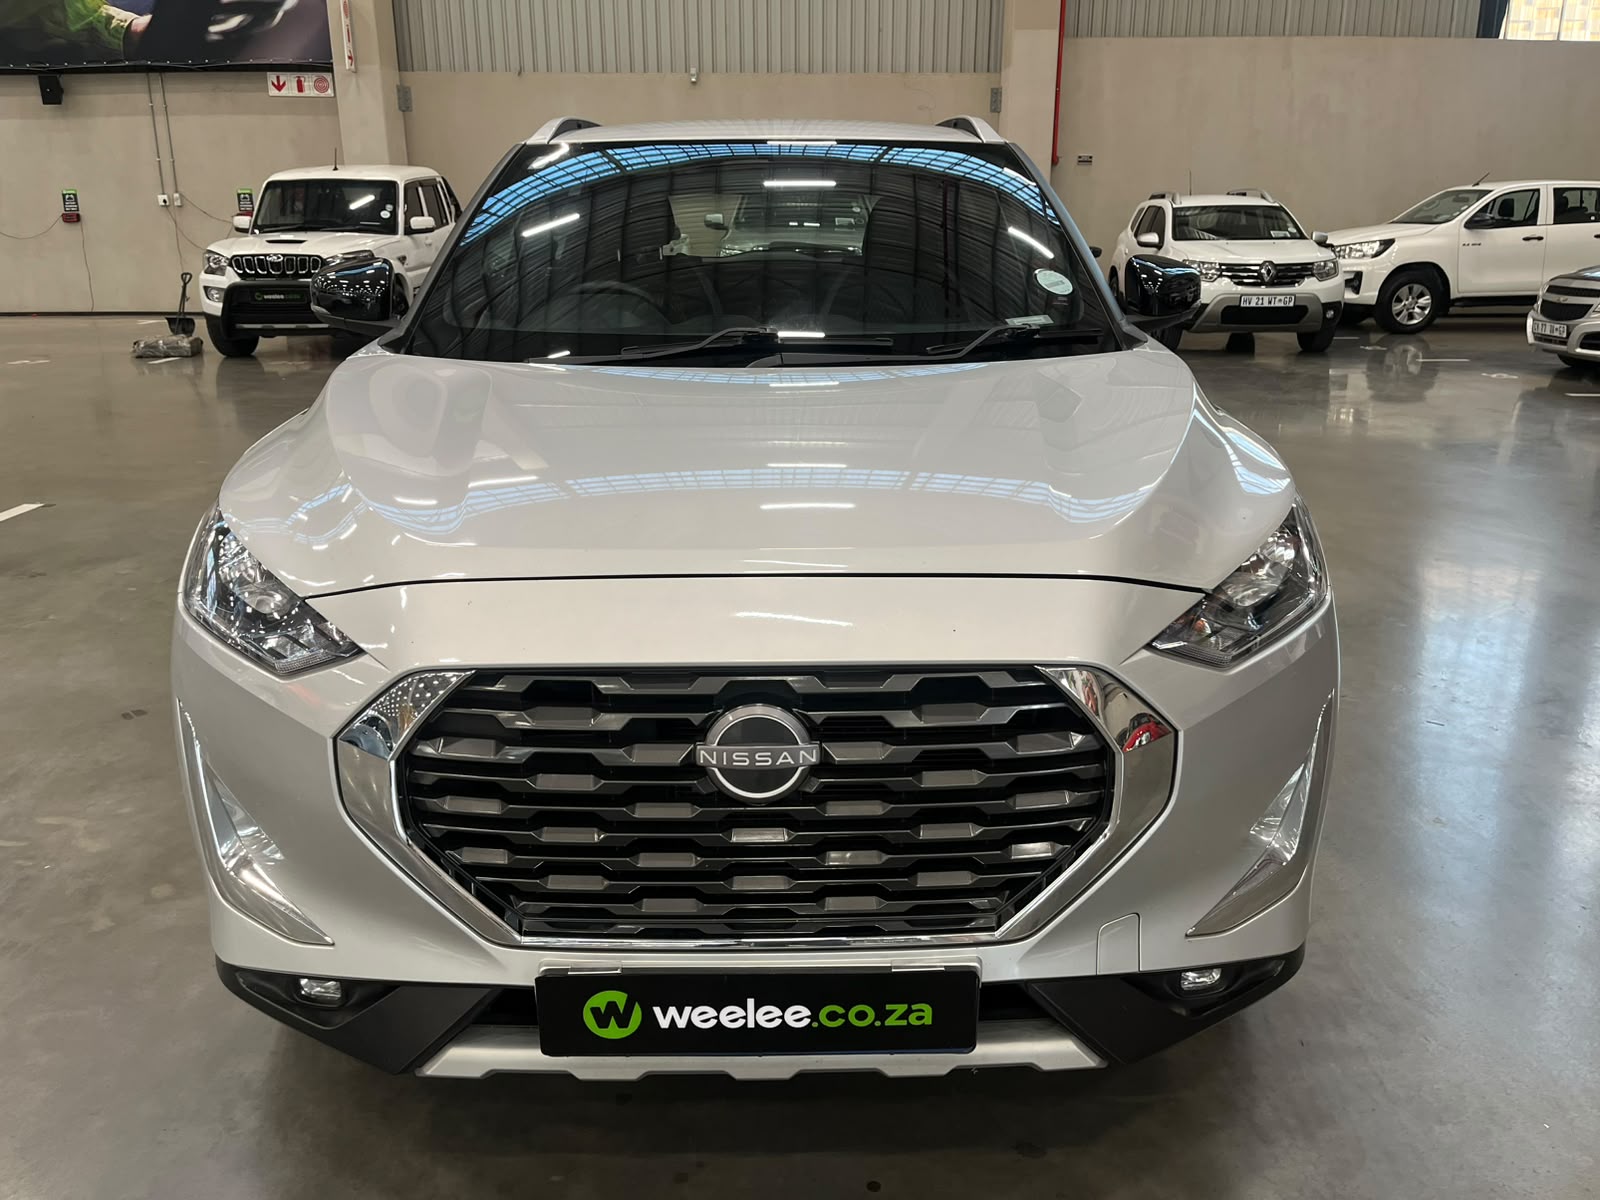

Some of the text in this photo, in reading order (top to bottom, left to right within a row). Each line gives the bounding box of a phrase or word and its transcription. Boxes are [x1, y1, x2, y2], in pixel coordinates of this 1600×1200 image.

[1255, 296, 1264, 305] 21
[1283, 297, 1293, 306] GP
[700, 749, 817, 766] NISSAN
[652, 998, 933, 1029] weelee.co.za
